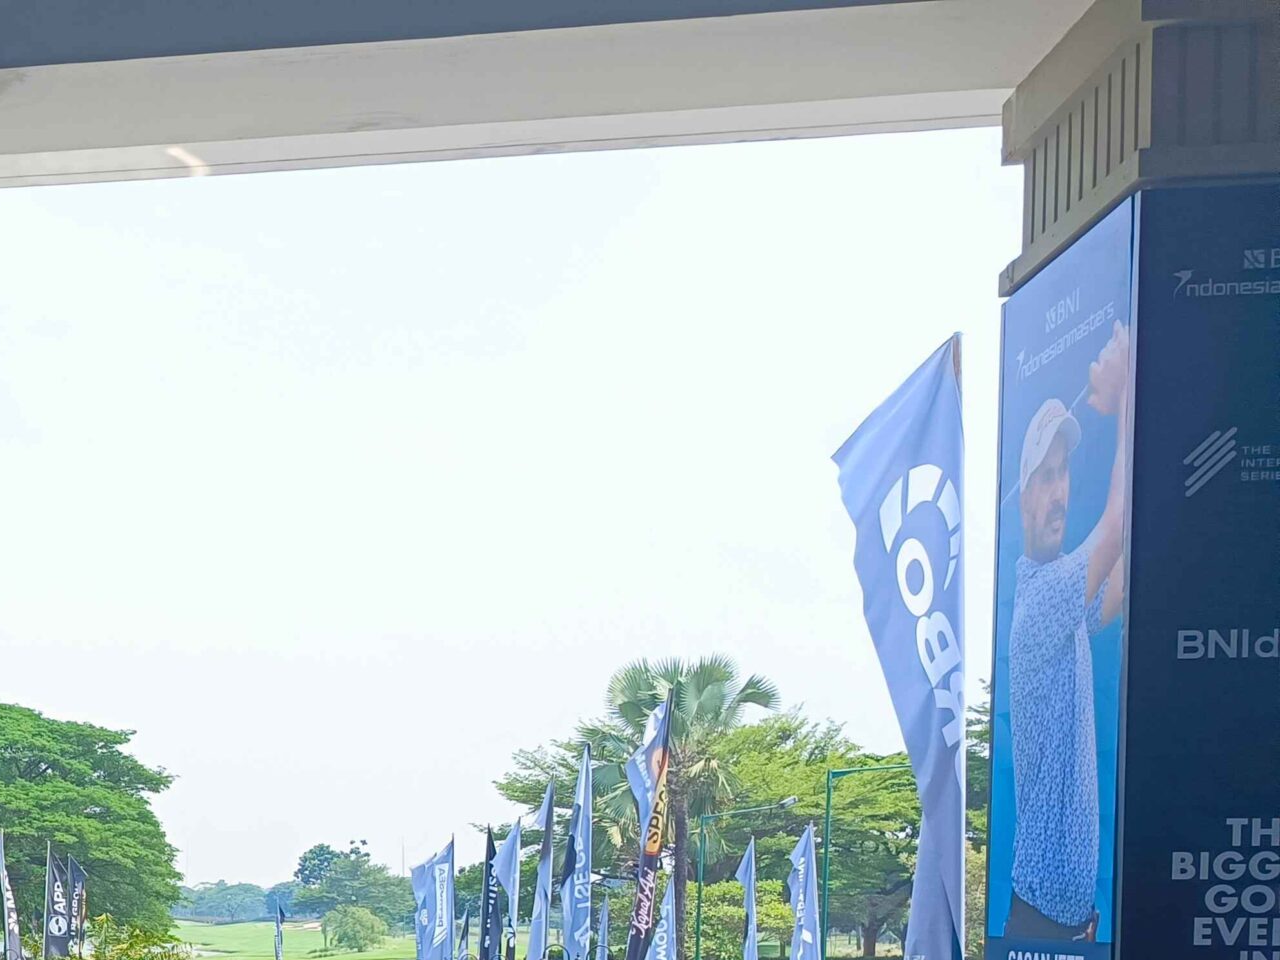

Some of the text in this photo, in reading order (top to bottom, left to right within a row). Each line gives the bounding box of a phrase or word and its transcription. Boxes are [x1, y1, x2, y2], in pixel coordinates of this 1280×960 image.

[1057, 287, 1081, 326] BNI
[1241, 445, 1272, 455] THE
[53, 881, 67, 914] APP
[1204, 884, 1280, 914] GO
